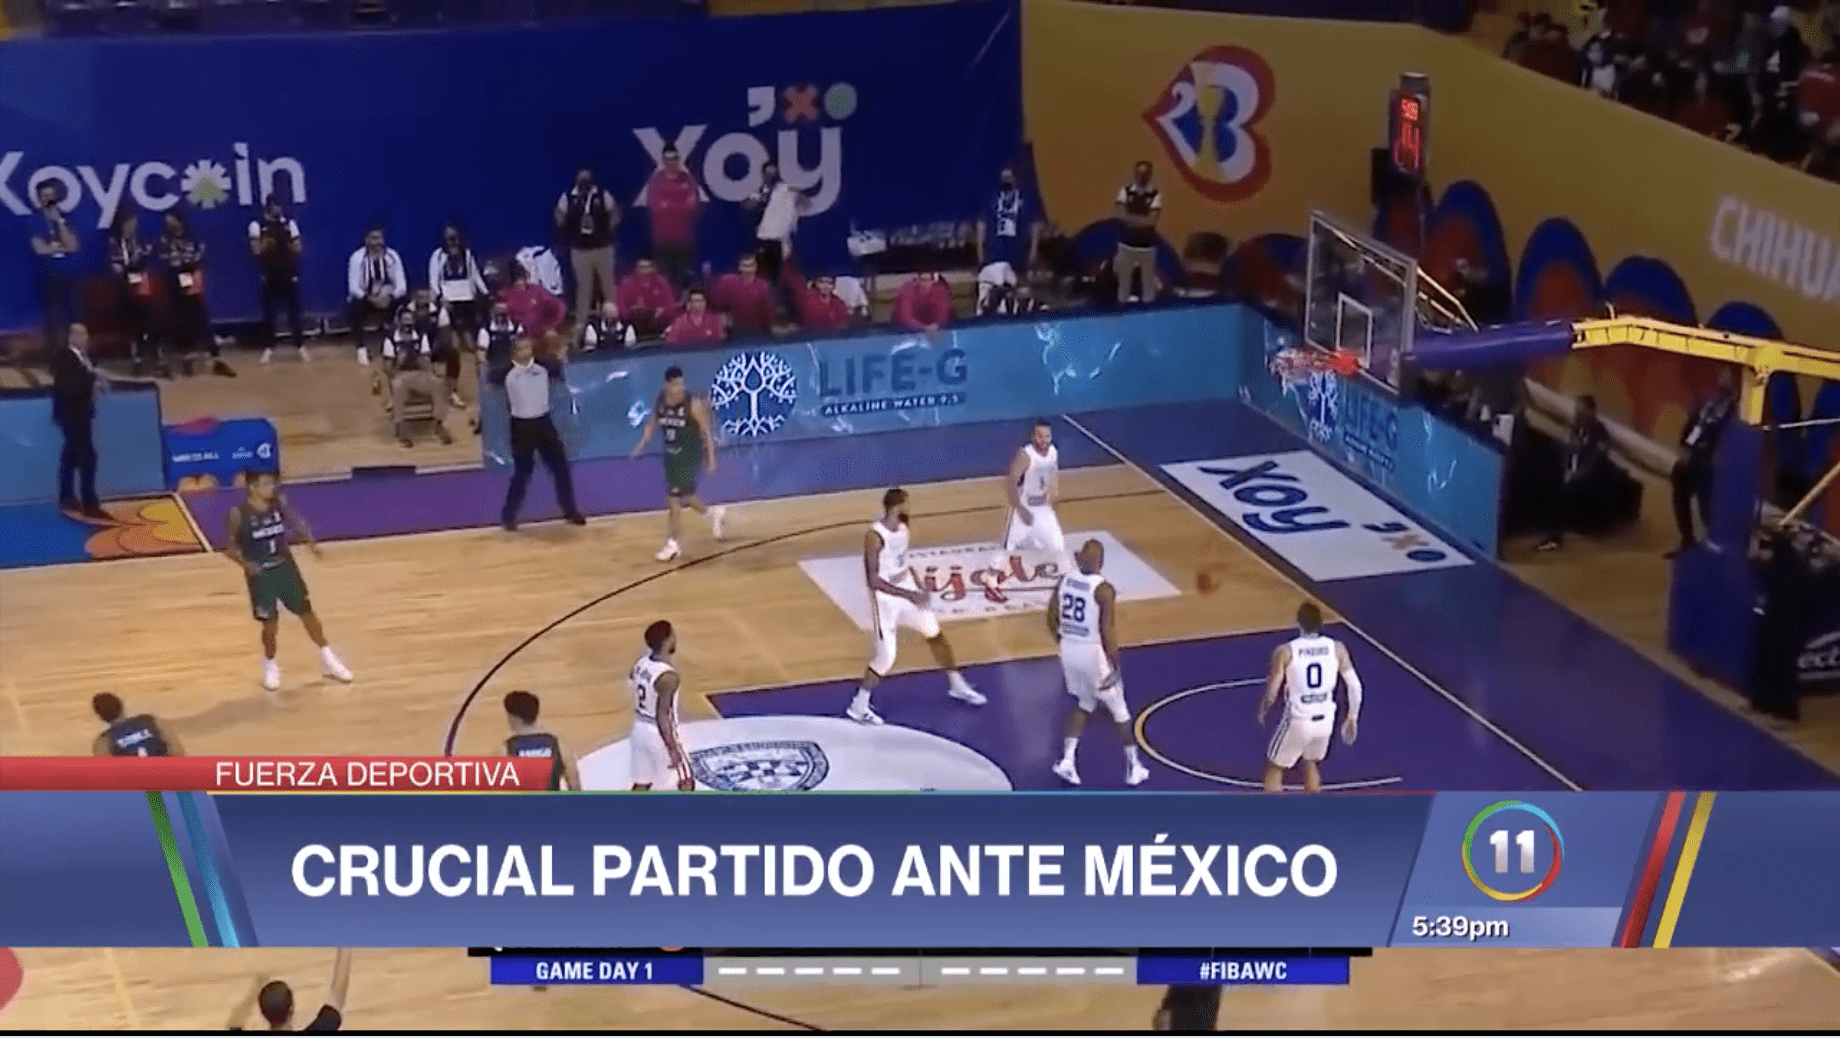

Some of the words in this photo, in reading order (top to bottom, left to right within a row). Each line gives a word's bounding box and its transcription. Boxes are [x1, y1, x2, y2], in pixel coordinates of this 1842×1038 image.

[819, 349, 967, 397] LIFE-G
[824, 399, 887, 416] ALKALINE
[1061, 592, 1086, 623] 28
[1307, 662, 1322, 689] 0
